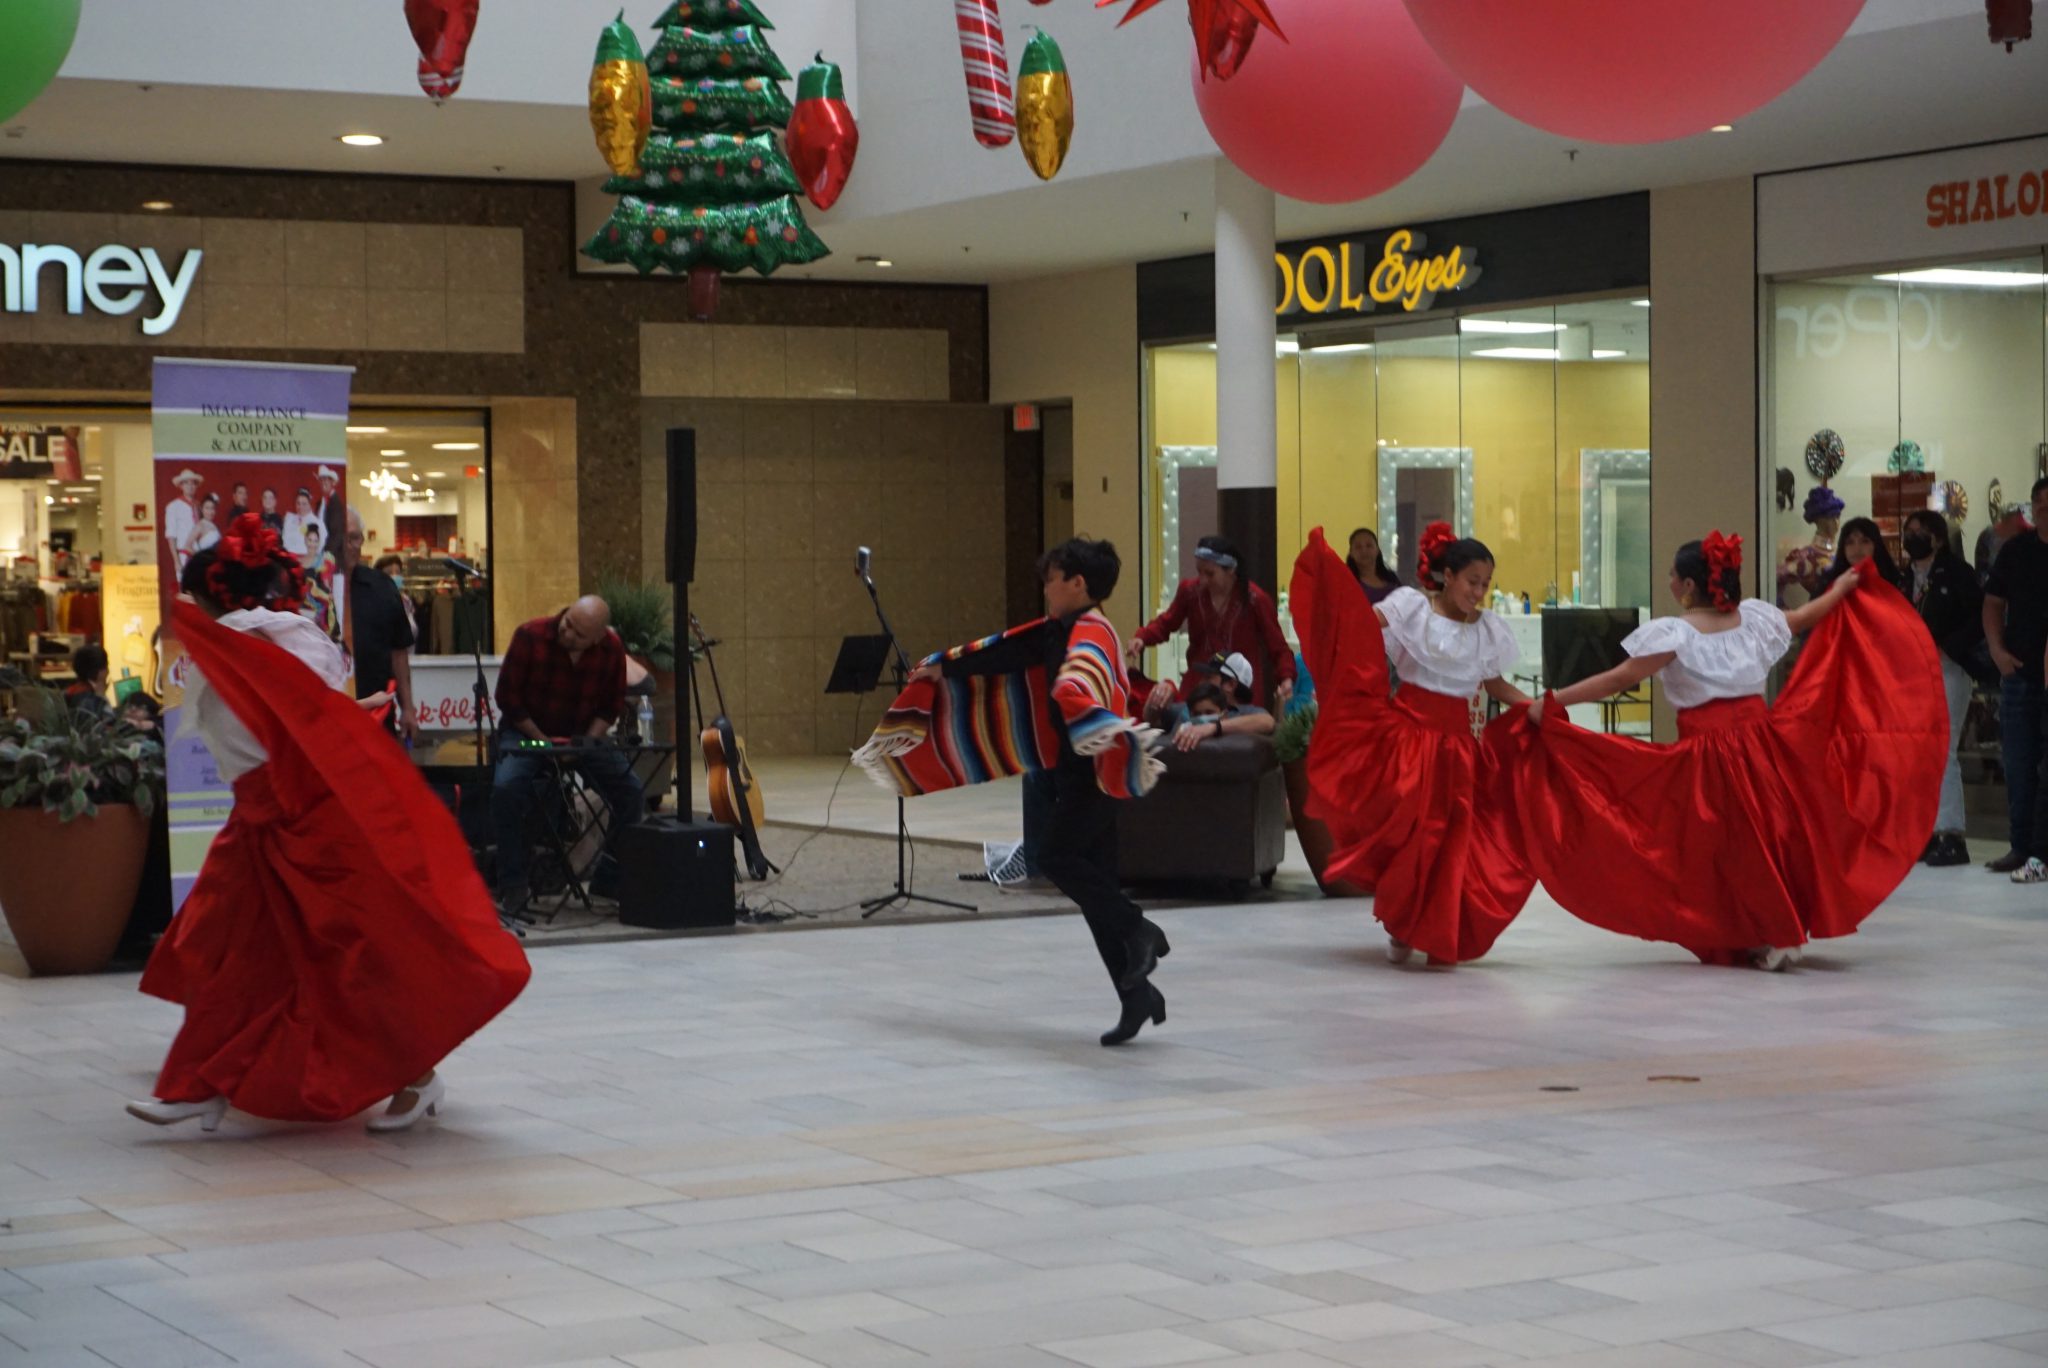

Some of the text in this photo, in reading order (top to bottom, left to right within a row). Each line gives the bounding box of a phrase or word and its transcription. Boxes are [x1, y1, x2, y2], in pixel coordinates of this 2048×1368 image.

[1369, 229, 1466, 312] Eyes
[202, 403, 306, 421] IMAGE DANCE
[217, 421, 294, 436] COMPANY
[212, 439, 302, 454] & ACADEMY
